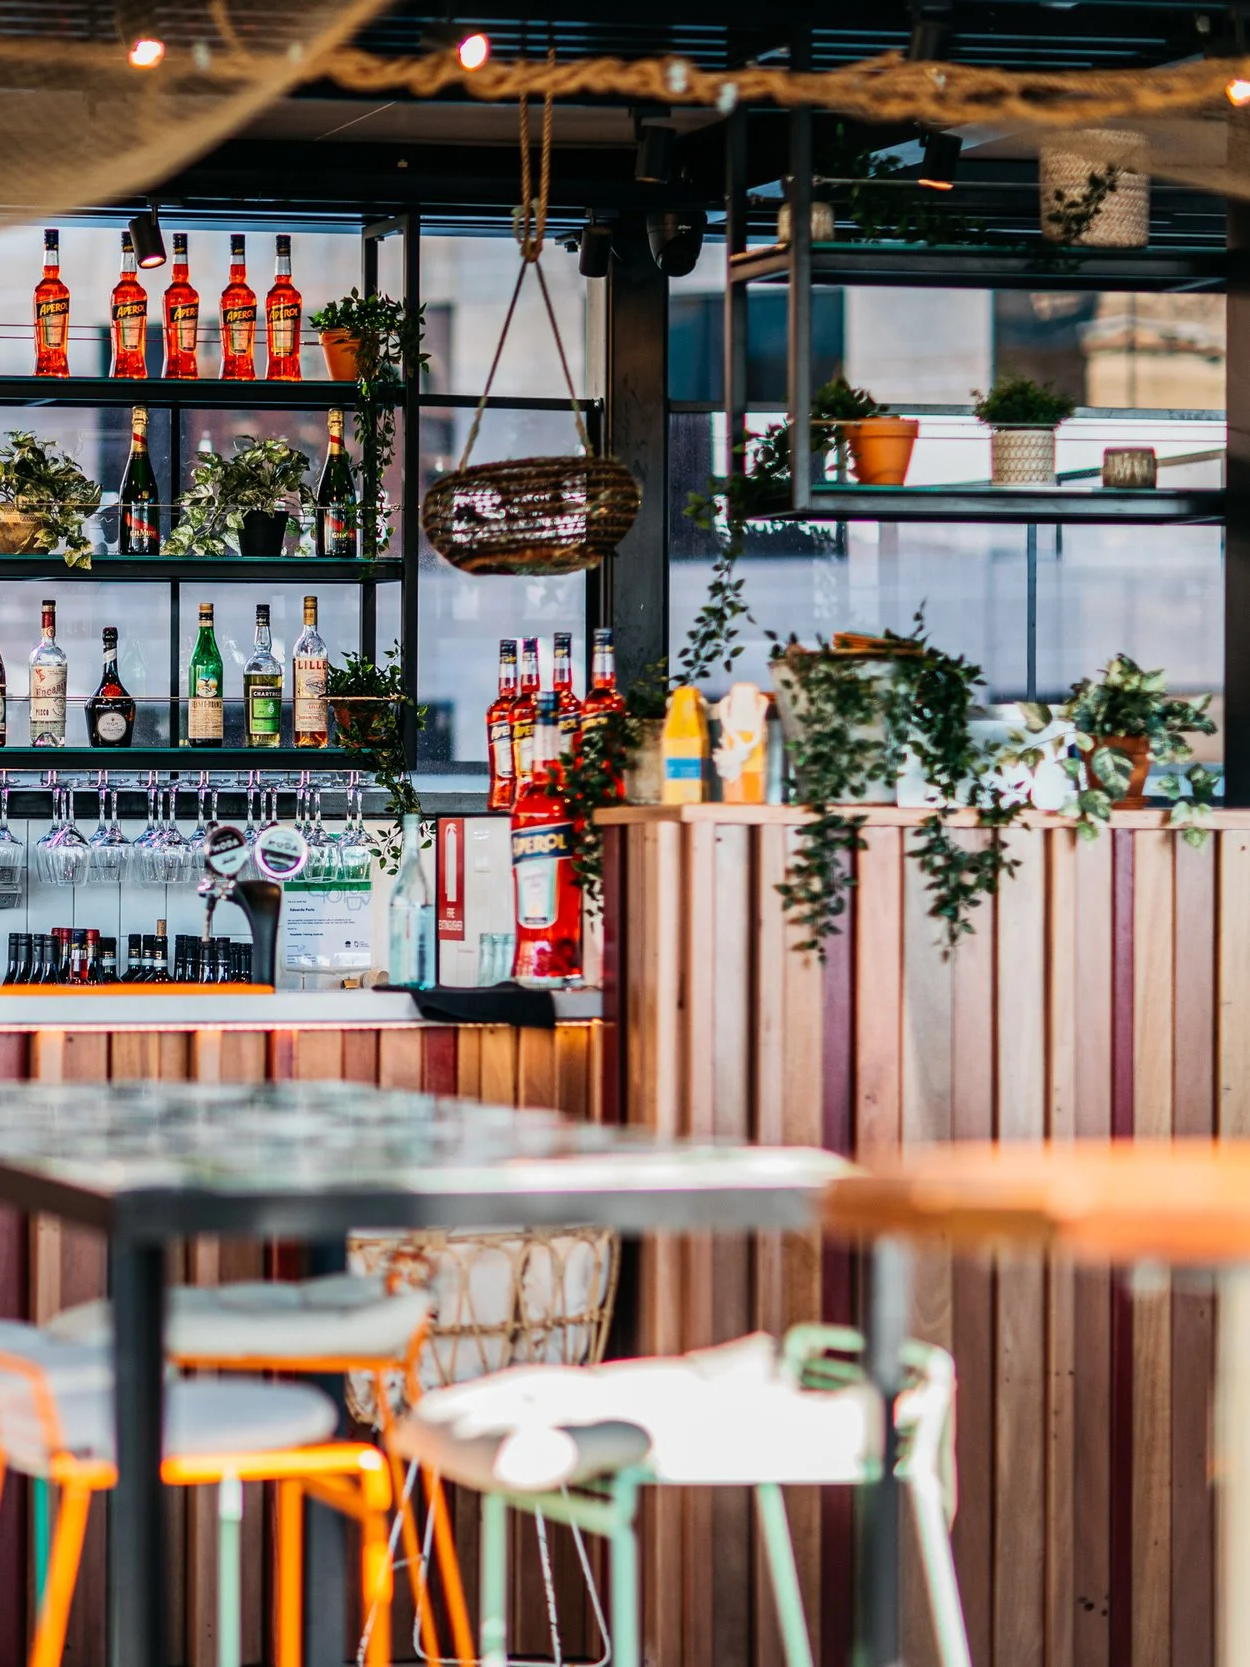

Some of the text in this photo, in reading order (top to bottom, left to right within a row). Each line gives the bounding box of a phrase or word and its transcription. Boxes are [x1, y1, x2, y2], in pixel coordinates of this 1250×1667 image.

[174, 306, 199, 320] APERO
[297, 660, 327, 670] LILLE
[35, 681, 67, 697] Encan
[35, 708, 50, 716] PISCO
[491, 725, 511, 740] APE
[513, 725, 534, 738] APE
